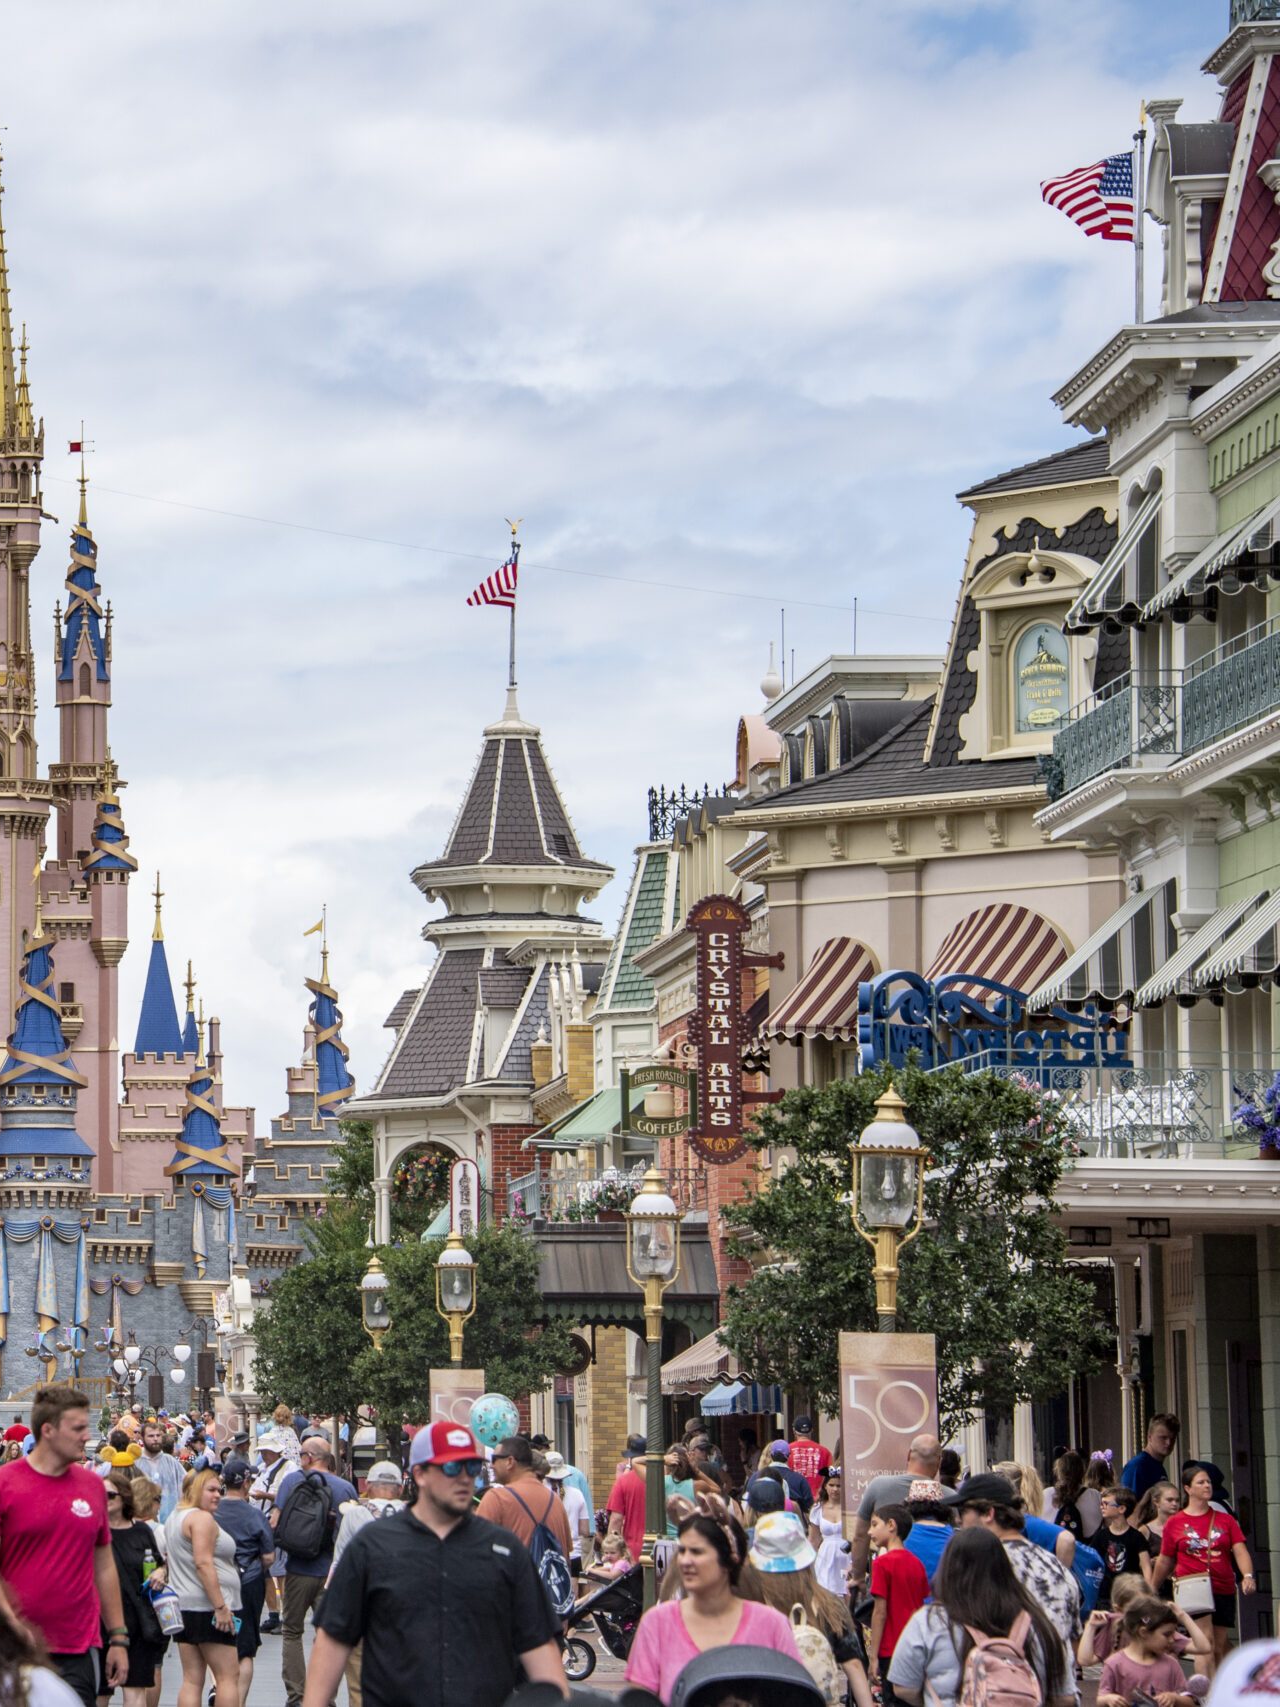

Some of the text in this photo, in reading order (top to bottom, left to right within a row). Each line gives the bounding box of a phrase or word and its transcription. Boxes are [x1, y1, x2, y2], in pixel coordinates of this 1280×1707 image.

[707, 933, 733, 1126] CRYSTAL ARTS
[634, 1070, 685, 1085] FRESH ROASTED
[637, 1120, 684, 1135] COFFEE
[849, 1375, 929, 1460] 50
